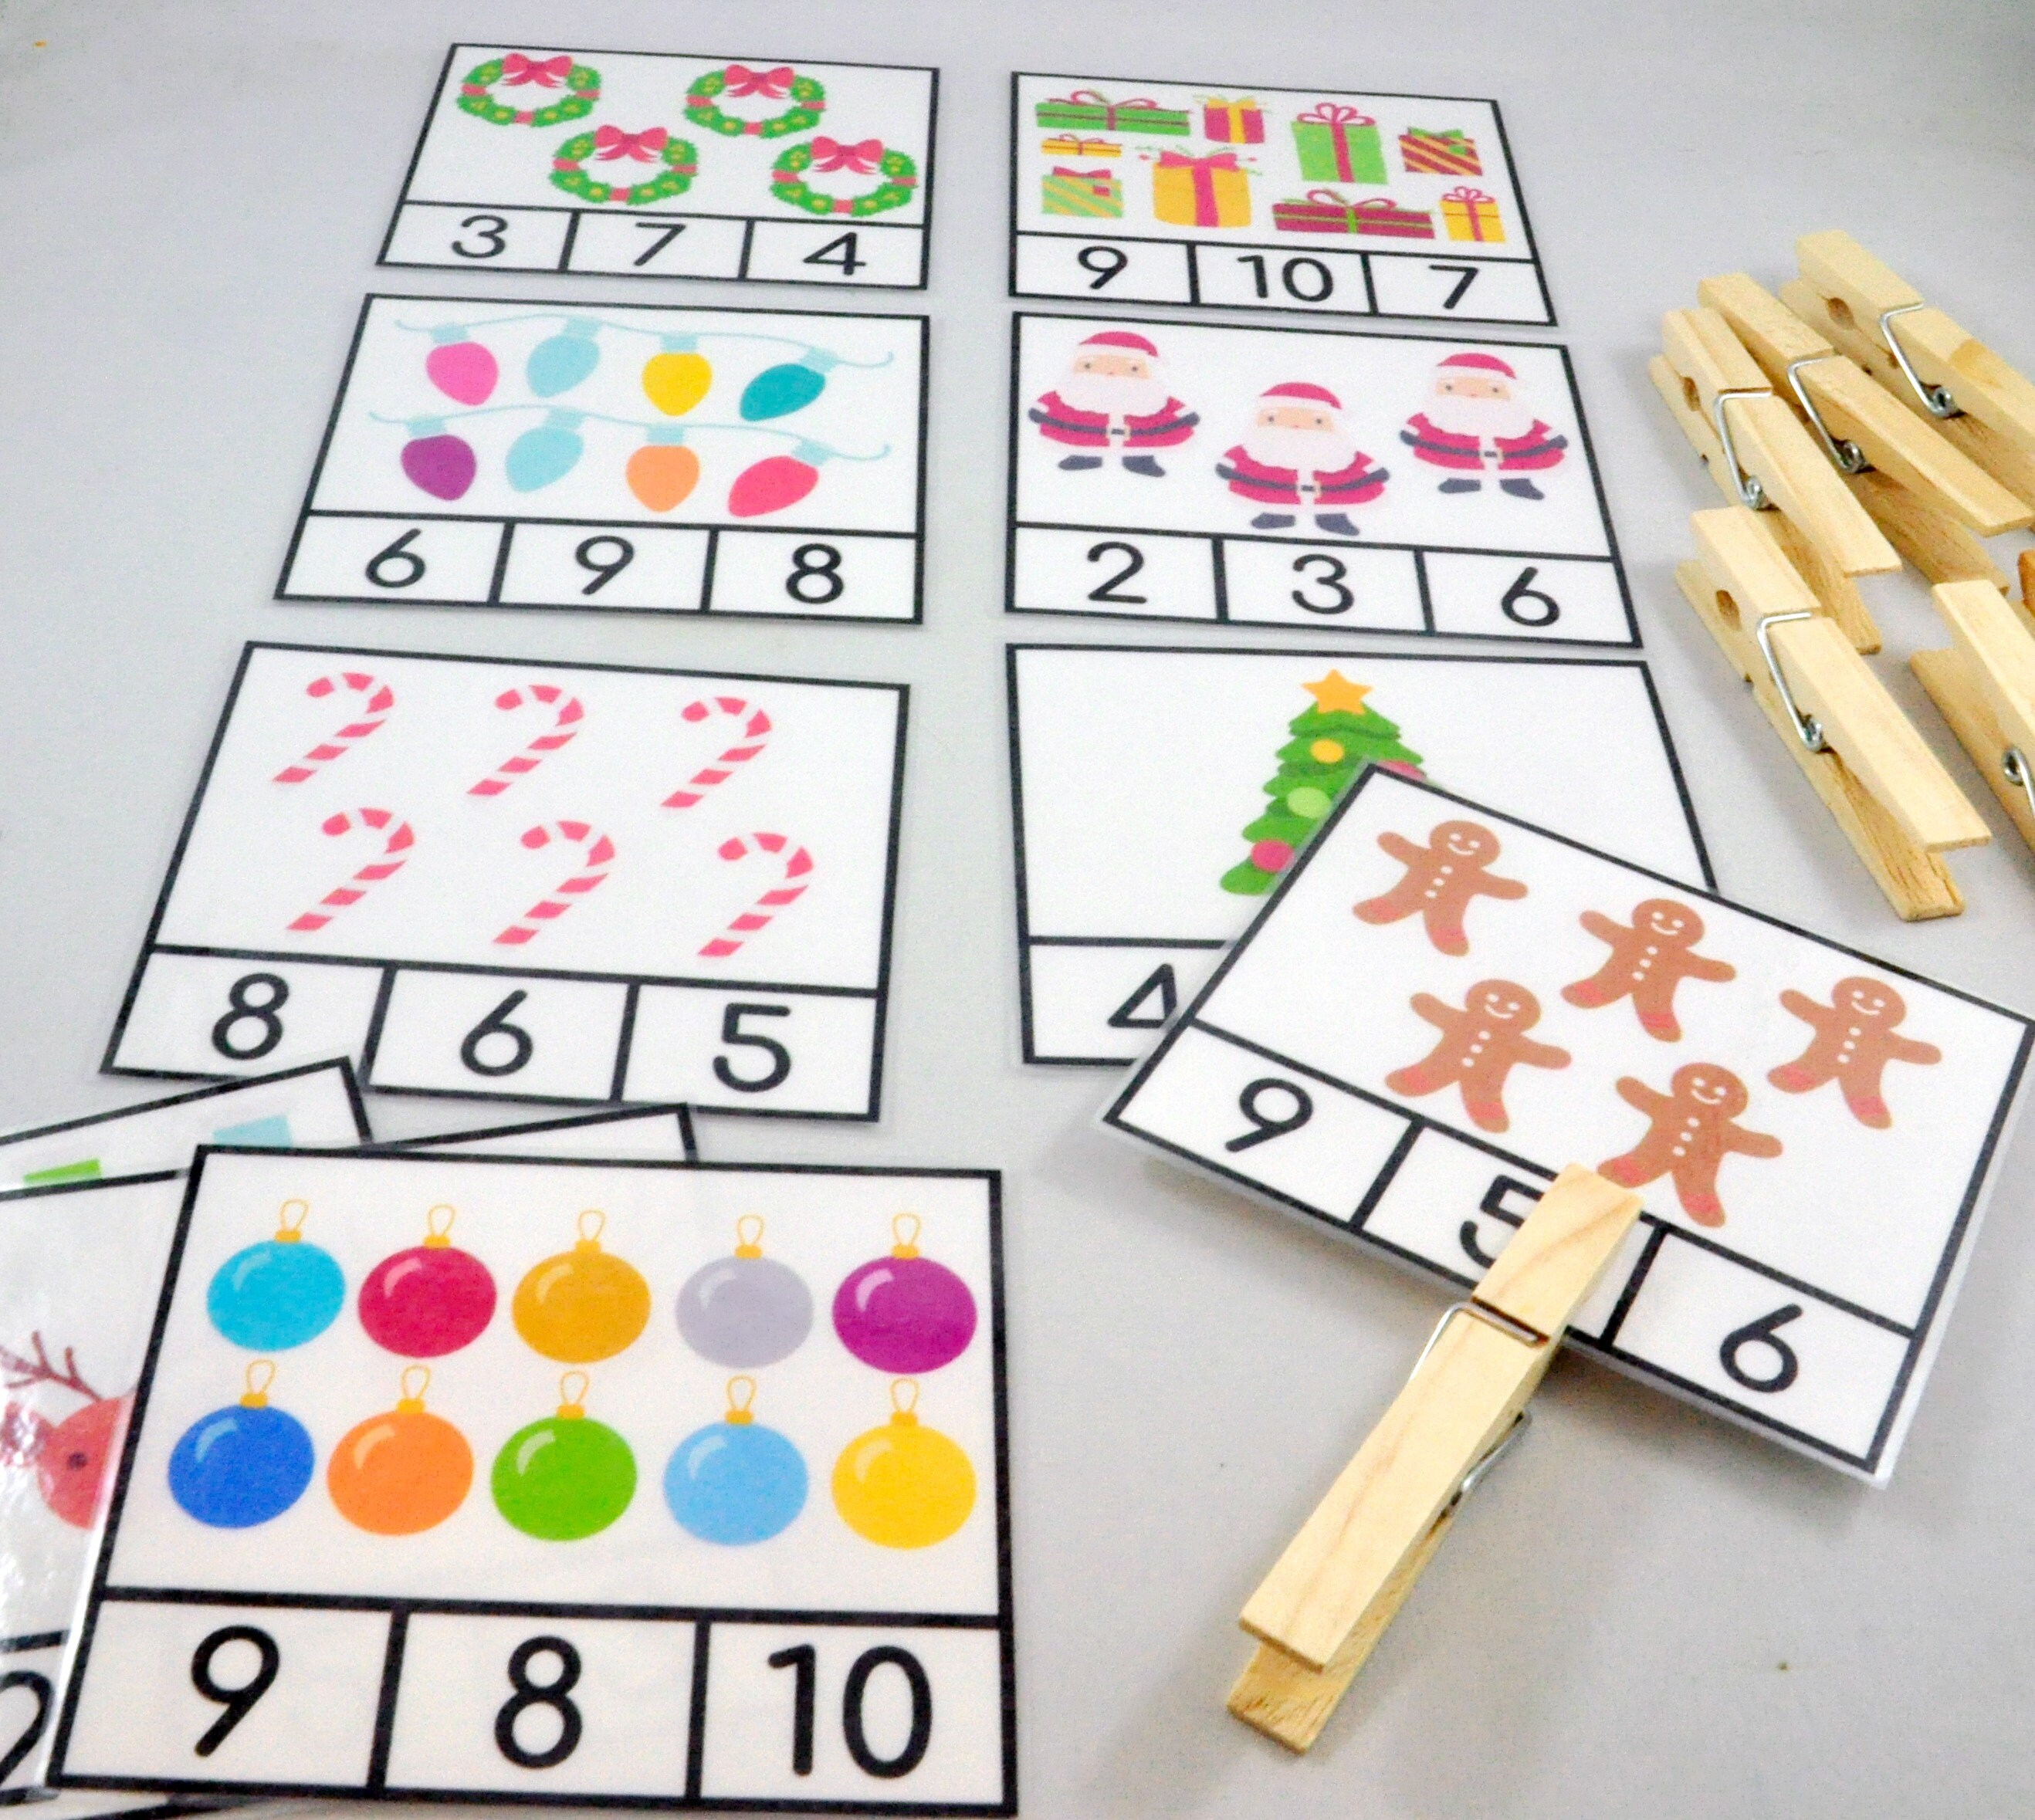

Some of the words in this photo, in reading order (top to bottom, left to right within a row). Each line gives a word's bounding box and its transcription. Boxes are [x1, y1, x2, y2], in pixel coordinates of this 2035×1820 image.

[452, 214, 508, 259] 3
[634, 222, 687, 267] 7
[803, 232, 867, 276] 4
[1077, 245, 1129, 290] 9
[1237, 254, 1334, 303] 10
[1428, 264, 1479, 310] 7
[365, 529, 426, 589] 6
[575, 535, 635, 596] 9
[785, 543, 845, 605] 8
[1087, 541, 1147, 604] 2
[1292, 553, 1354, 615] 3
[1501, 566, 1560, 628] 6
[211, 973, 290, 1061] 8
[460, 989, 533, 1077] 6
[713, 1002, 791, 1093] 5
[1107, 962, 1178, 1030] 4
[1225, 1077, 1313, 1153] 9
[1718, 1304, 1803, 1394] 6
[190, 1624, 281, 1758] 9
[493, 1636, 584, 1770] 8
[767, 1643, 933, 1780] 10
